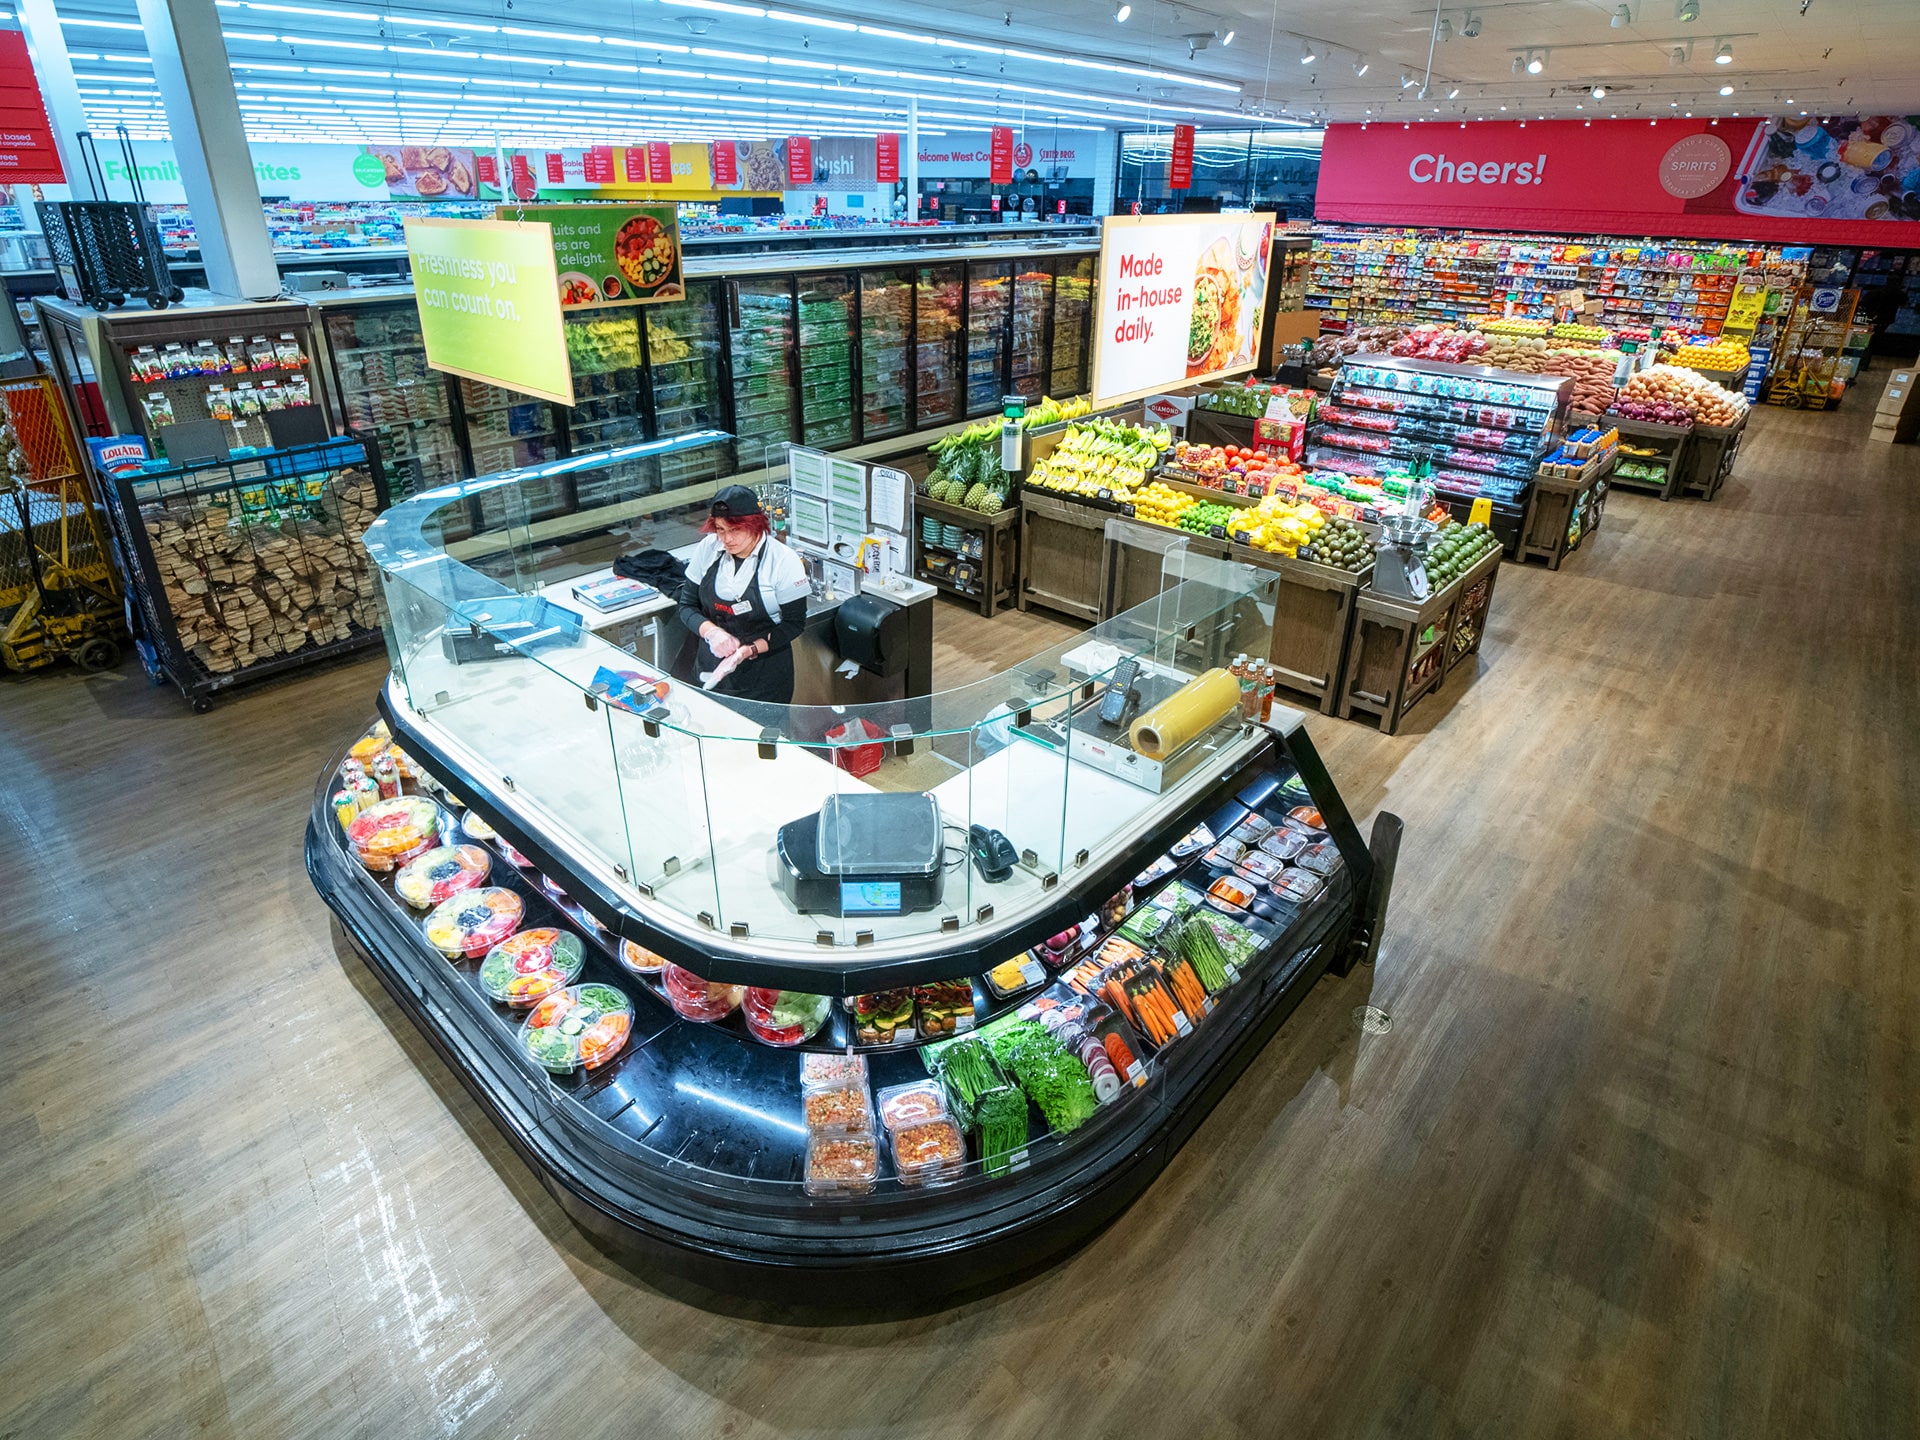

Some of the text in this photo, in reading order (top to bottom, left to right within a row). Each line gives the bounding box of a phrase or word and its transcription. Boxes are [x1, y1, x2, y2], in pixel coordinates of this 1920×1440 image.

[994, 128, 1001, 139] 12
[1177, 126, 1184, 138] 13
[790, 138, 798, 147] 10
[952, 152, 974, 162] West
[254, 161, 301, 181] rites
[814, 155, 854, 174] Sushi
[1409, 153, 1547, 185] Cheers!
[1671, 161, 1717, 171] SPIRITS
[553, 223, 601, 236] uits and
[570, 241, 590, 250] are
[560, 252, 606, 267] delight.
[1120, 252, 1163, 279] Made
[417, 249, 517, 288] Freshness you
[423, 287, 520, 321] can count on.
[1117, 285, 1182, 311] in-house
[1115, 315, 1154, 344] daily.
[1152, 405, 1179, 415] DIAMOND
[102, 446, 142, 460] LouAna
